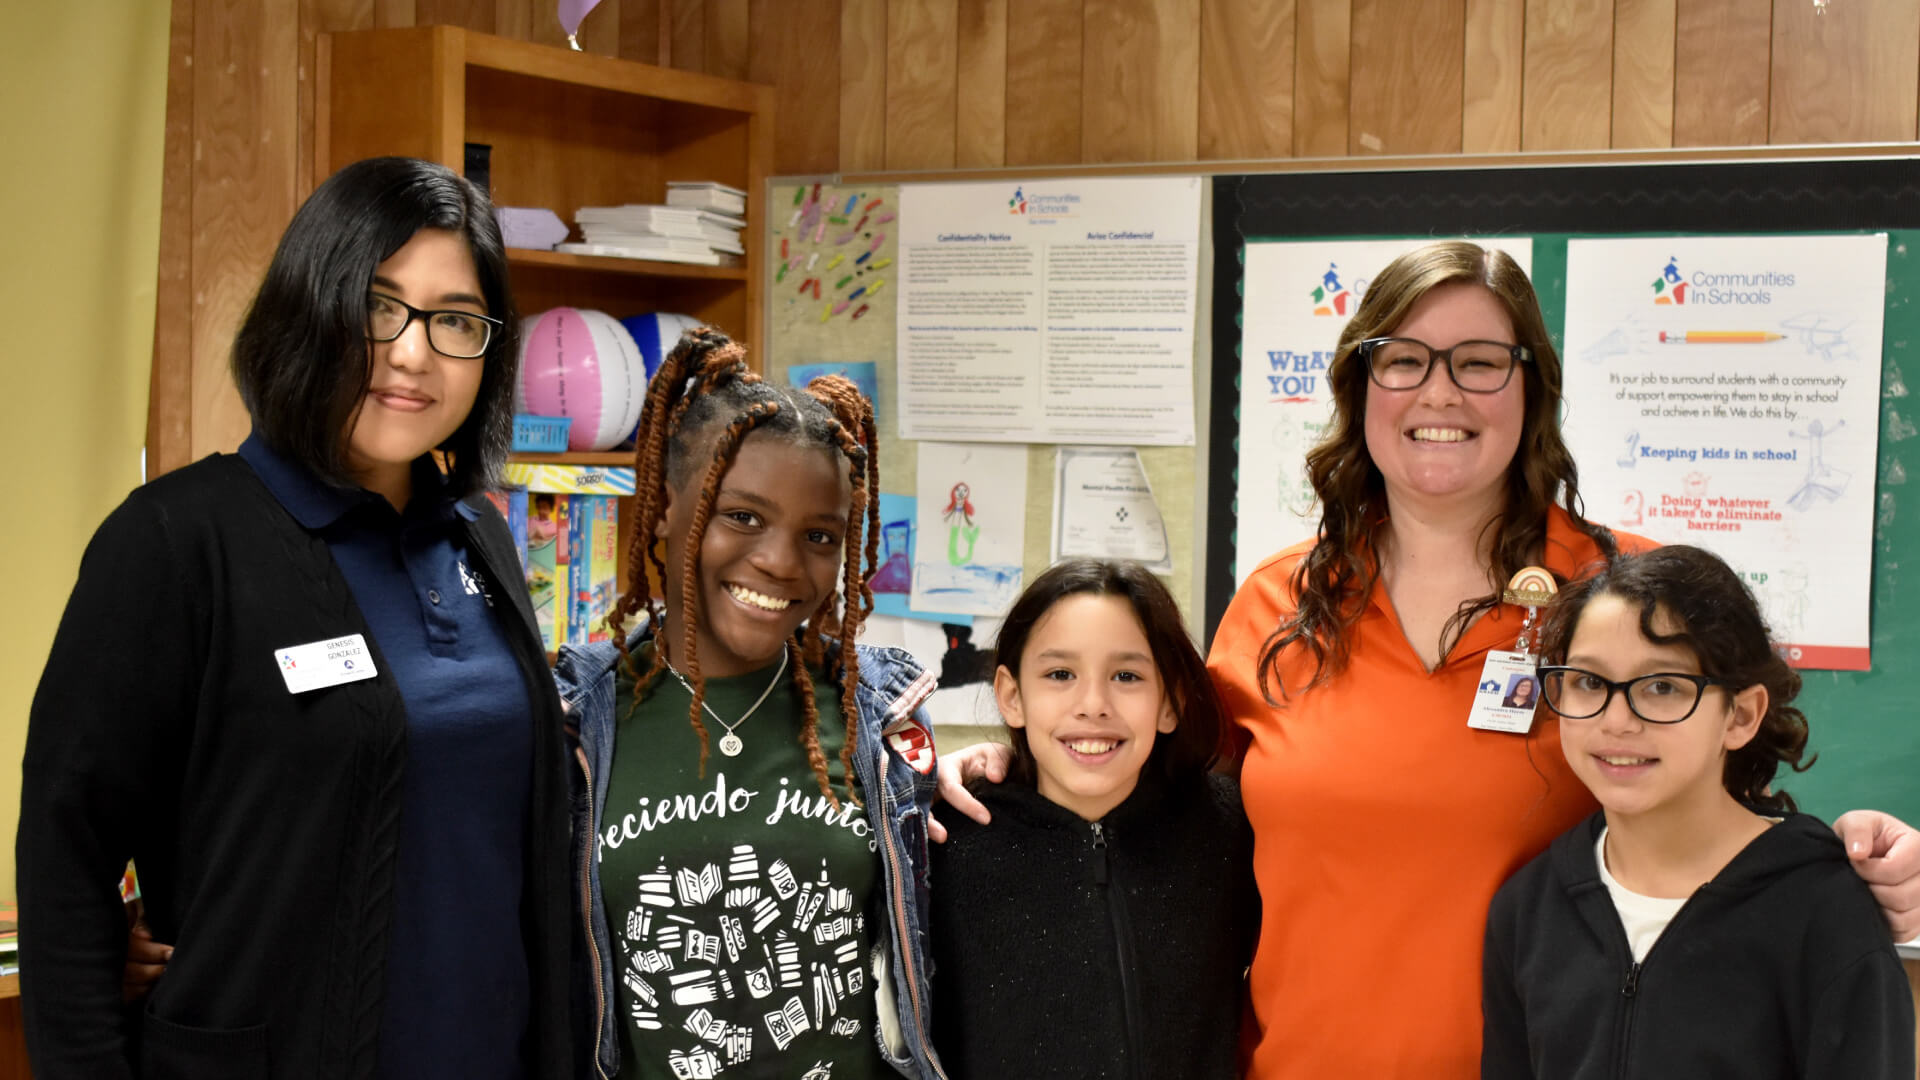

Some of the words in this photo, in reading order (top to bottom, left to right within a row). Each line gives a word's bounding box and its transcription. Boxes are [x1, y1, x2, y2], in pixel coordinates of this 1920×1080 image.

[1030, 194, 1081, 203] Communities
[1038, 205, 1068, 213] Schools
[937, 232, 987, 243] Confidentiality
[989, 232, 1012, 241] Notice
[1087, 231, 1107, 240] Aviso
[1109, 231, 1154, 240] Confidencial
[1692, 270, 1795, 287] Communities
[1692, 289, 1706, 304] In
[1708, 288, 1771, 305] Schools
[1267, 376, 1316, 396] YOU
[1623, 375, 1638, 385] our
[1641, 372, 1657, 387] job
[1659, 373, 1669, 384] to
[1671, 372, 1715, 385] surround
[1717, 373, 1756, 385] students
[1758, 373, 1779, 385] with
[1782, 377, 1789, 386] a
[1791, 375, 1847, 389] community
[1616, 387, 1626, 400] of
[1667, 391, 1729, 404] empowering
[1731, 389, 1756, 401] them
[1759, 391, 1769, 401] to
[1771, 392, 1791, 405] stay
[1794, 391, 1803, 401] in
[1806, 390, 1839, 402] school
[1641, 405, 1660, 417] and
[1663, 404, 1699, 417] achieve
[1702, 406, 1710, 417] in
[1730, 406, 1747, 417] We
[1749, 406, 1763, 418] do
[1766, 407, 1781, 418] this
[1640, 446, 1697, 462] Keeping
[1702, 447, 1730, 459] kids
[1735, 449, 1748, 460] in
[1752, 449, 1797, 461] school
[1661, 494, 1702, 509] Doing
[1706, 496, 1770, 509] whatever
[1648, 506, 1657, 517] it
[1661, 507, 1696, 518] takes
[1700, 508, 1712, 518] to
[1716, 509, 1782, 521] eliminate
[1687, 519, 1741, 531] barriers
[1750, 572, 1769, 585] up
[326, 639, 355, 650] GENESIS
[327, 647, 361, 660] GONZALEZ
[598, 772, 759, 863] reciendo
